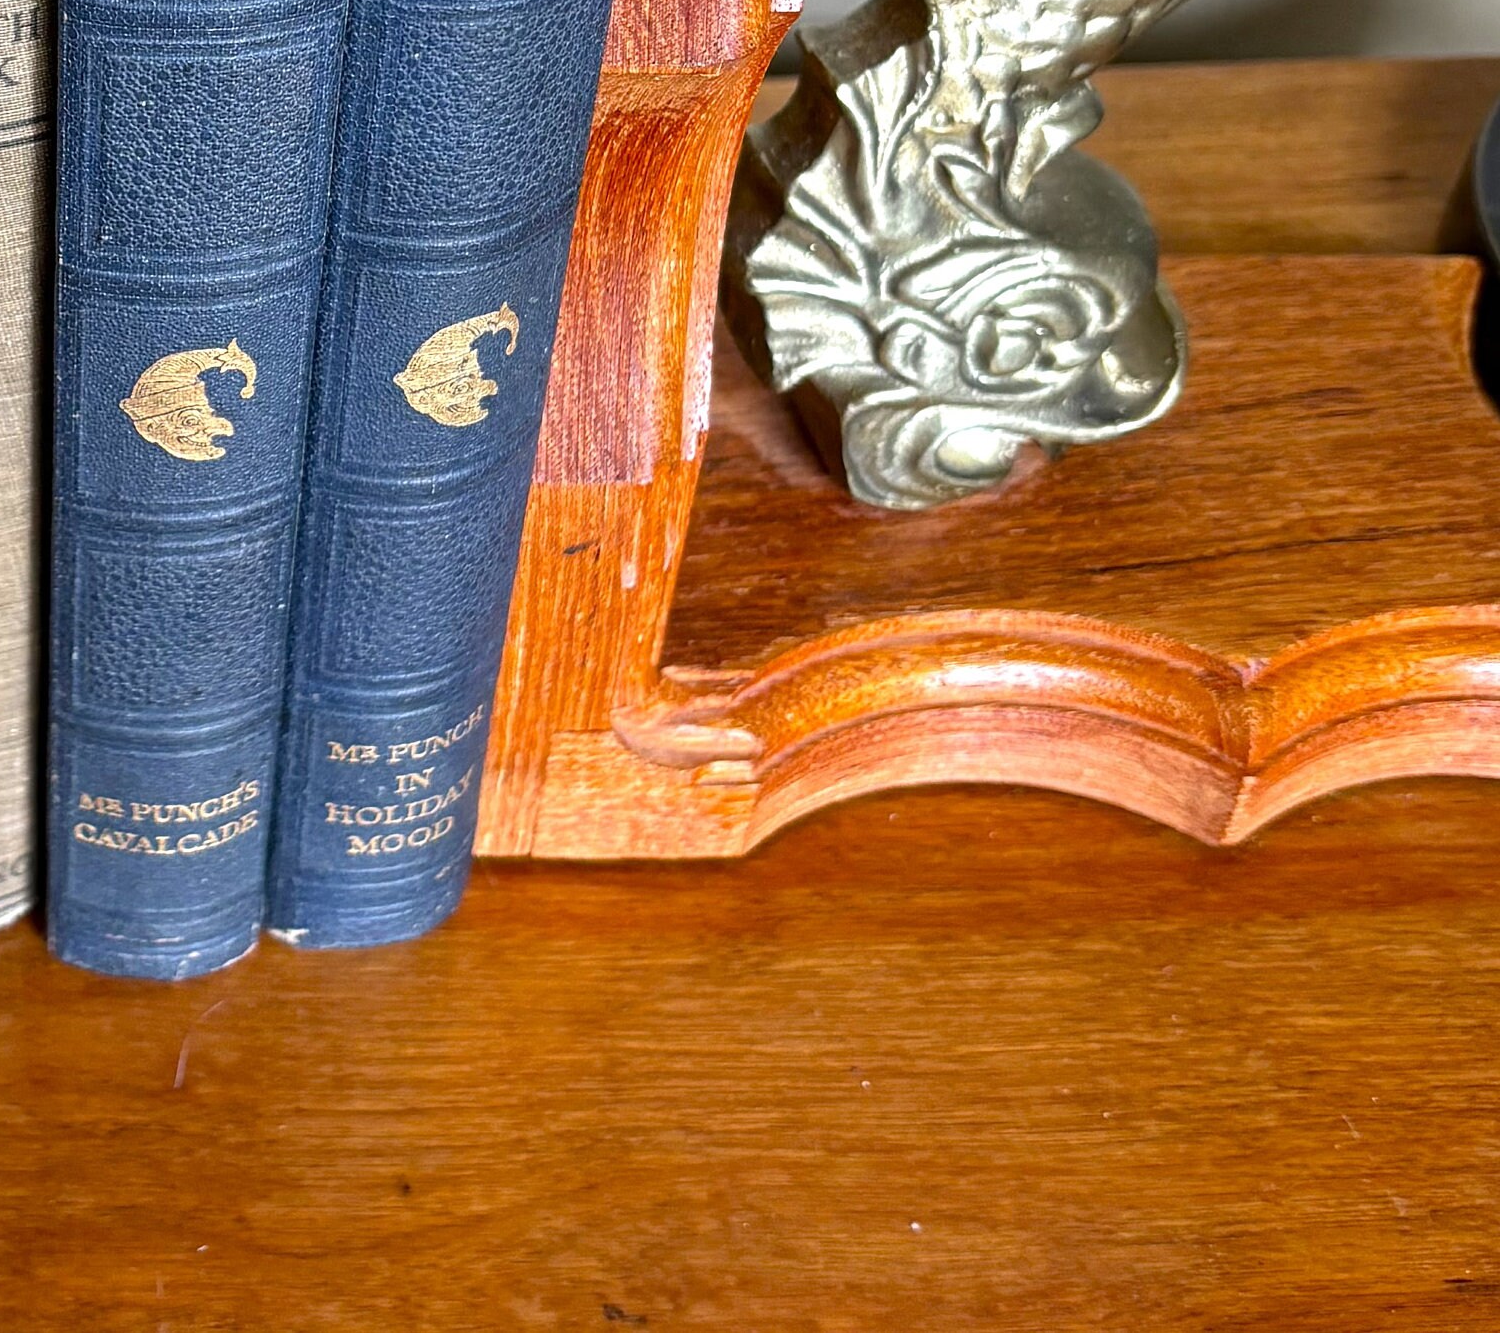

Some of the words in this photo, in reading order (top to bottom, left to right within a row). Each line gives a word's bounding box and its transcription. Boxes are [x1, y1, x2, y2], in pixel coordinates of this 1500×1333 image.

[386, 704, 485, 765] PUNCH
[130, 779, 261, 823] PUNCH'S
[324, 764, 475, 826] HOLIDAY
[394, 766, 435, 795] IN
[73, 809, 259, 855] CAVALCADE
[347, 816, 455, 855] MOOD
